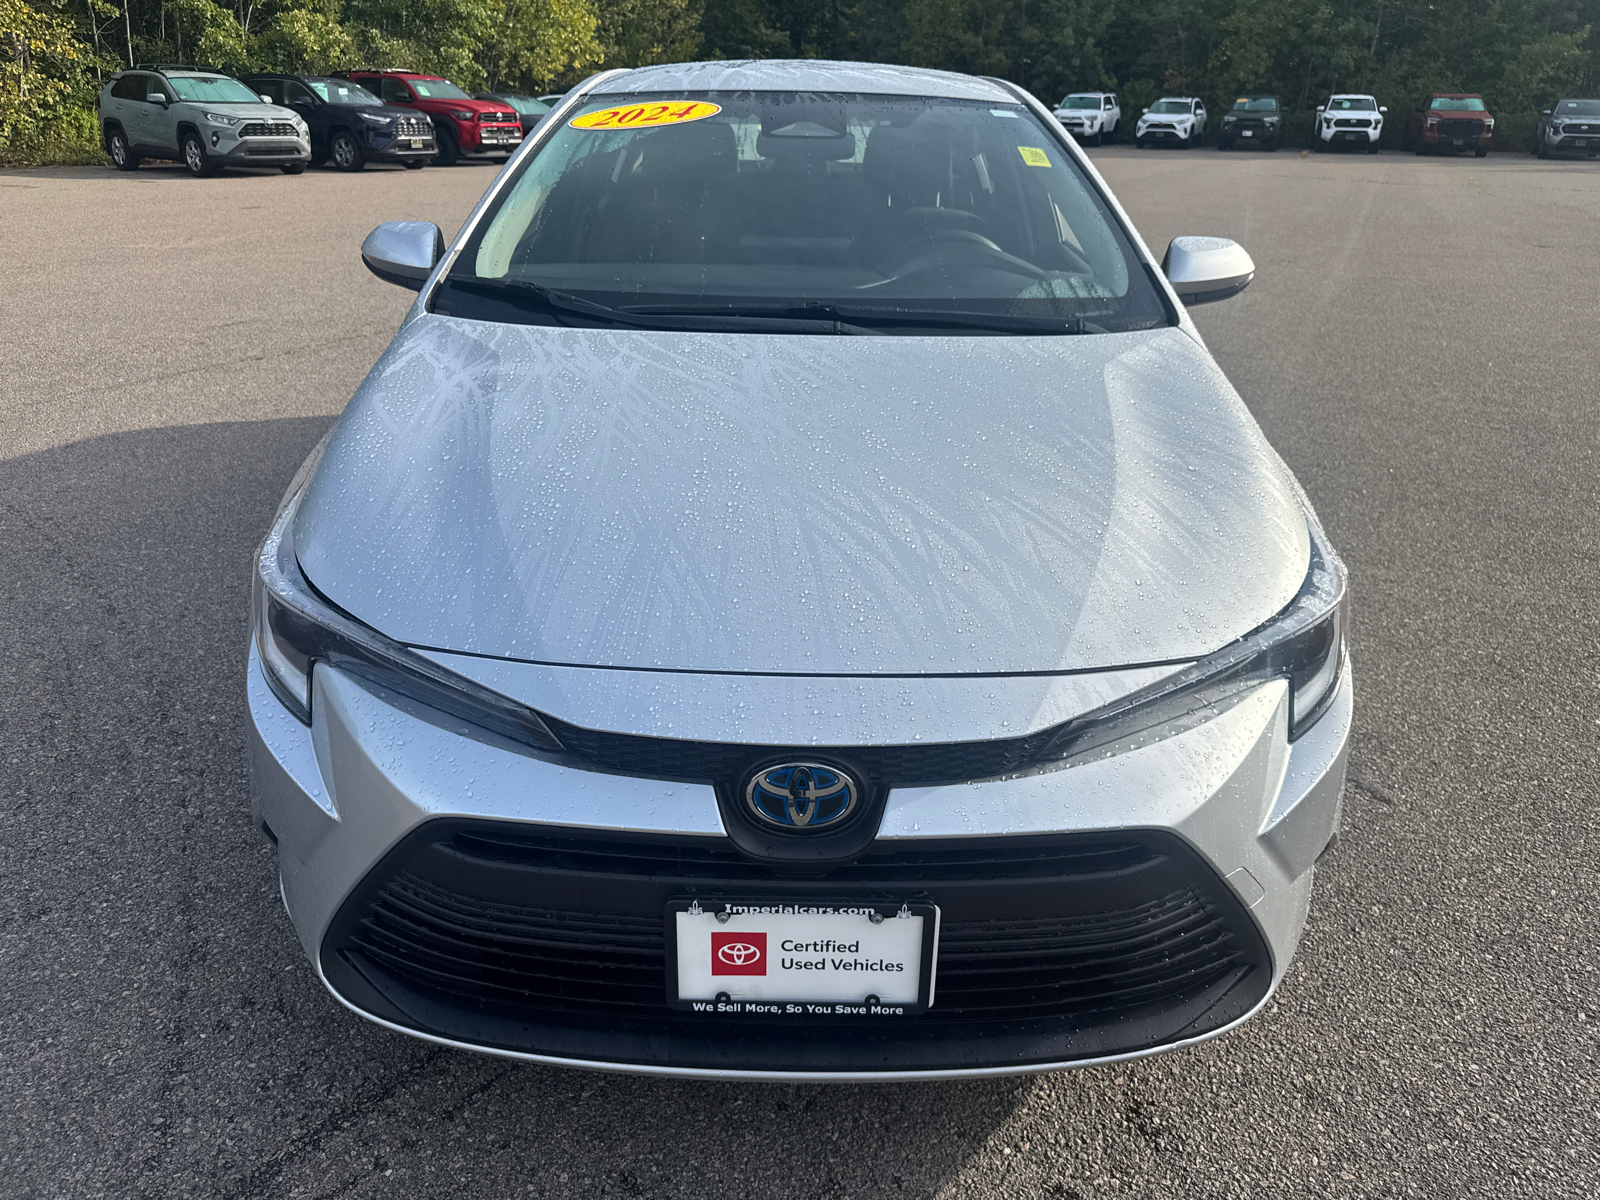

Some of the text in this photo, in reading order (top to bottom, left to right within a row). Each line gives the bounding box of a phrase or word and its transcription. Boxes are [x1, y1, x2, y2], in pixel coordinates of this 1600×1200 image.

[590, 103, 700, 127] 2024
[724, 903, 876, 916] Imperialcars.com
[780, 939, 860, 953] Certified
[780, 957, 904, 972] Used Vehicles
[692, 1002, 904, 1015] We Sell More, So You Save More
